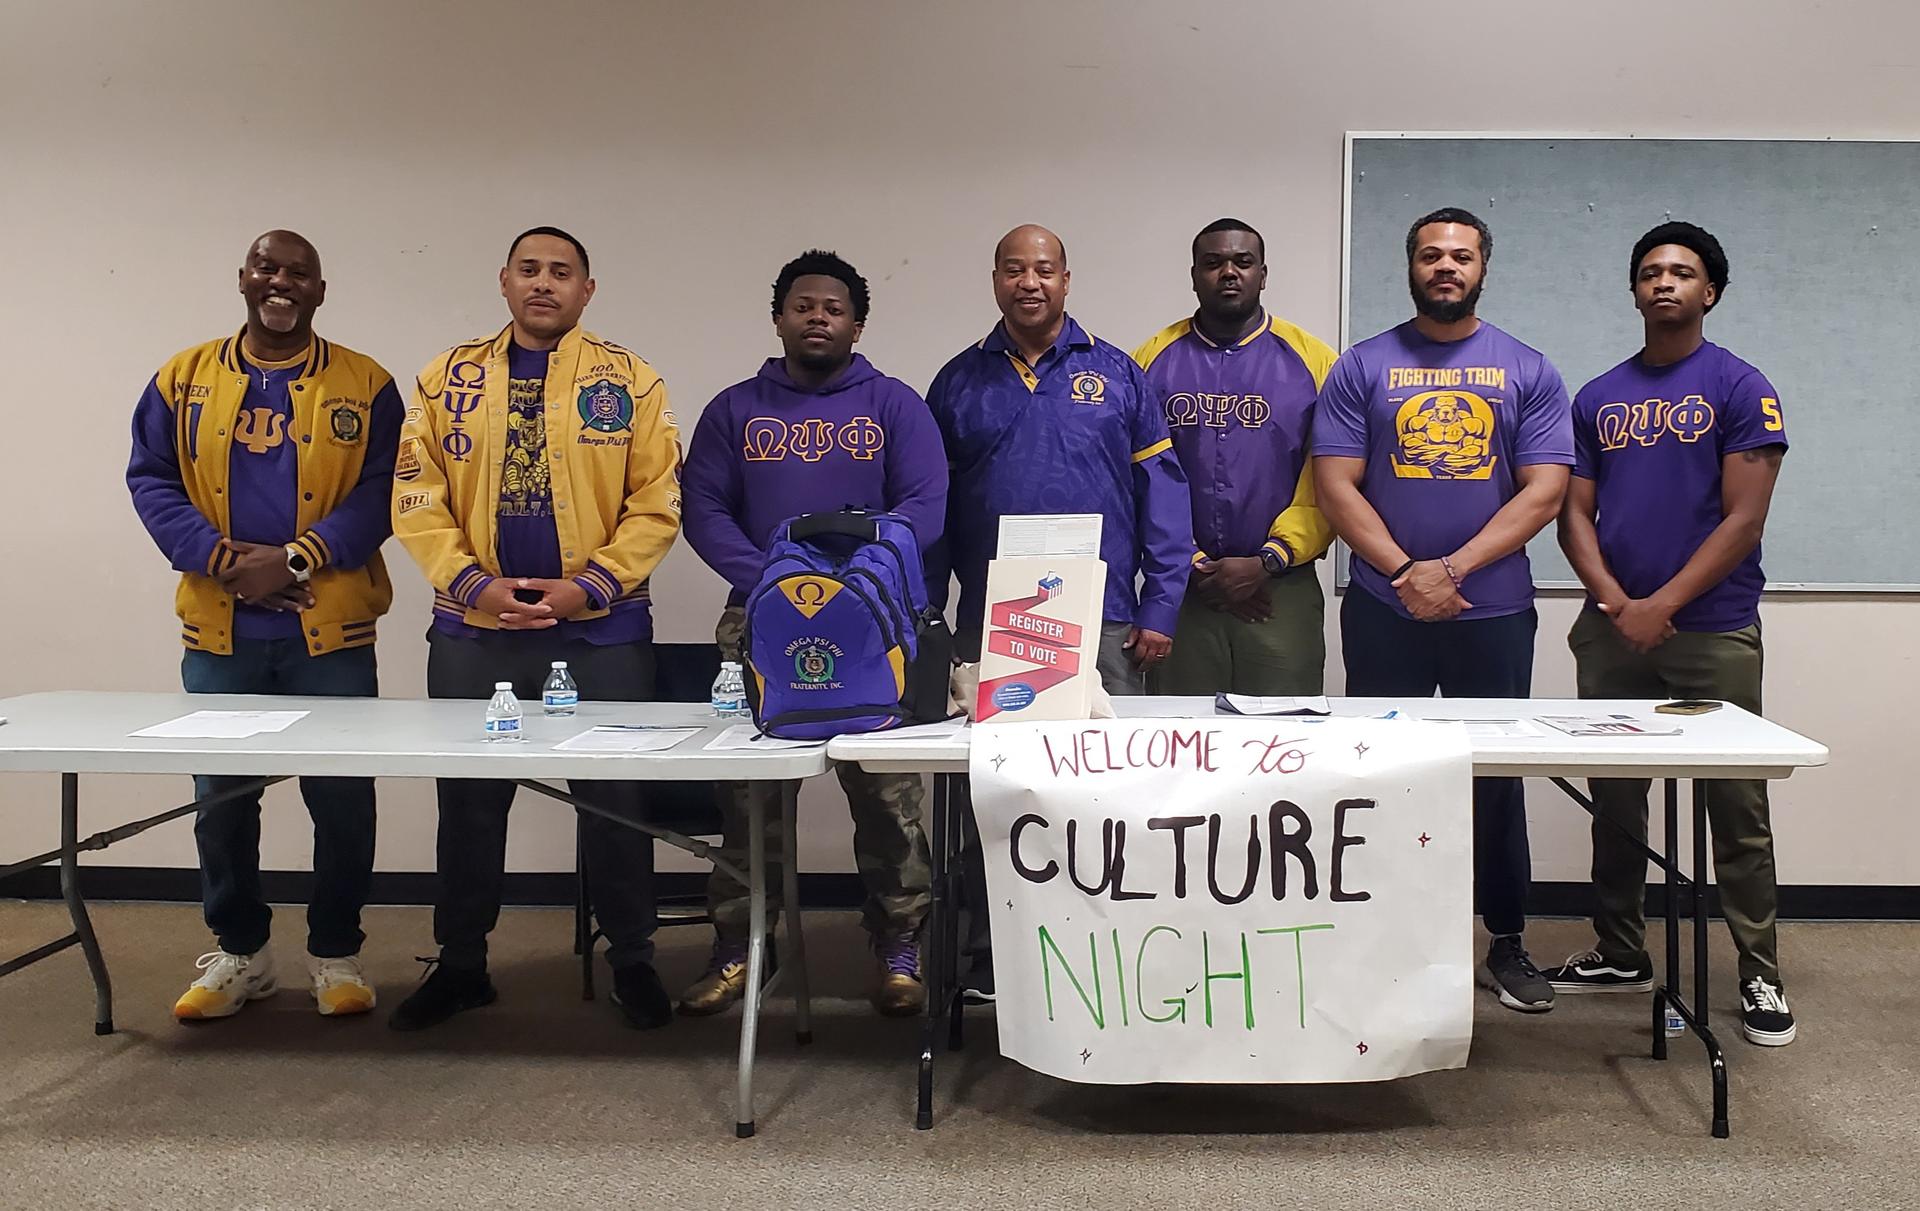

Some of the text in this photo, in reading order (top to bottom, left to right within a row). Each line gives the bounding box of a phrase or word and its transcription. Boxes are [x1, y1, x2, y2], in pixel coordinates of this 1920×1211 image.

[591, 363, 614, 373] 100
[1388, 366, 1506, 391] FIGHTING TRIM
[1165, 393, 1271, 428] ΩΨΦ
[1596, 395, 1715, 450] ΩΨΦ
[1760, 397, 1783, 432] 5
[744, 416, 885, 462] ΩΨΦ
[400, 495, 425, 510] 1977
[794, 581, 825, 606] Ω
[1008, 613, 1064, 638] REGISTER
[784, 637, 844, 657] OMEGA PSI PHI
[1010, 641, 1058, 665] TO VOTE
[1043, 729, 1315, 777] WELCOME to
[1009, 799, 1380, 905] CULTURE
[1038, 923, 1335, 1031] NIGHT
